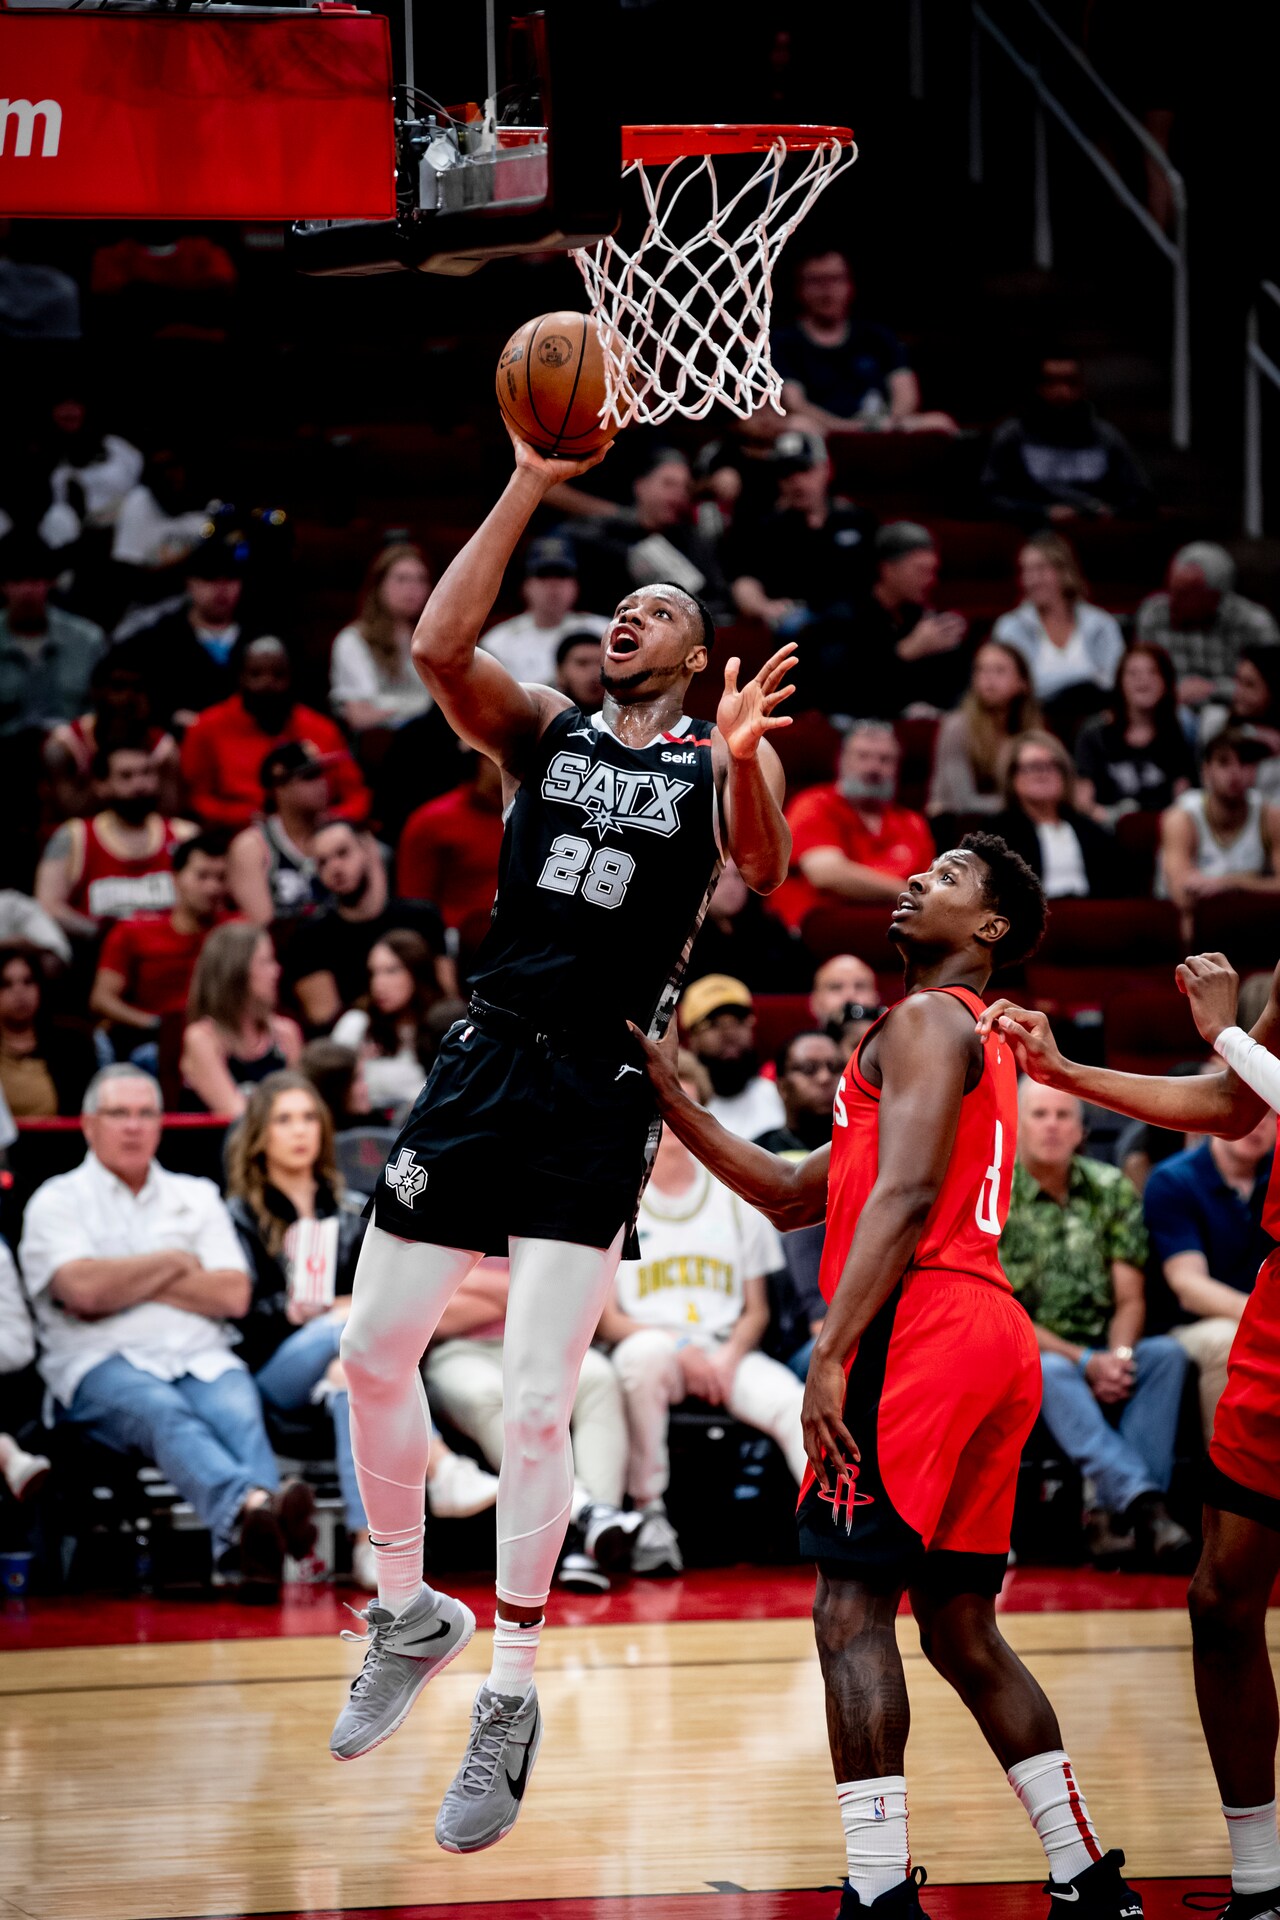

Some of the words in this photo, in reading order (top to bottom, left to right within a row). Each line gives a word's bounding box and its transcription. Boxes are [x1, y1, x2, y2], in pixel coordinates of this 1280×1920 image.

[541, 750, 695, 838] SATX
[660, 751, 697, 764] Self.
[537, 833, 636, 909] 28
